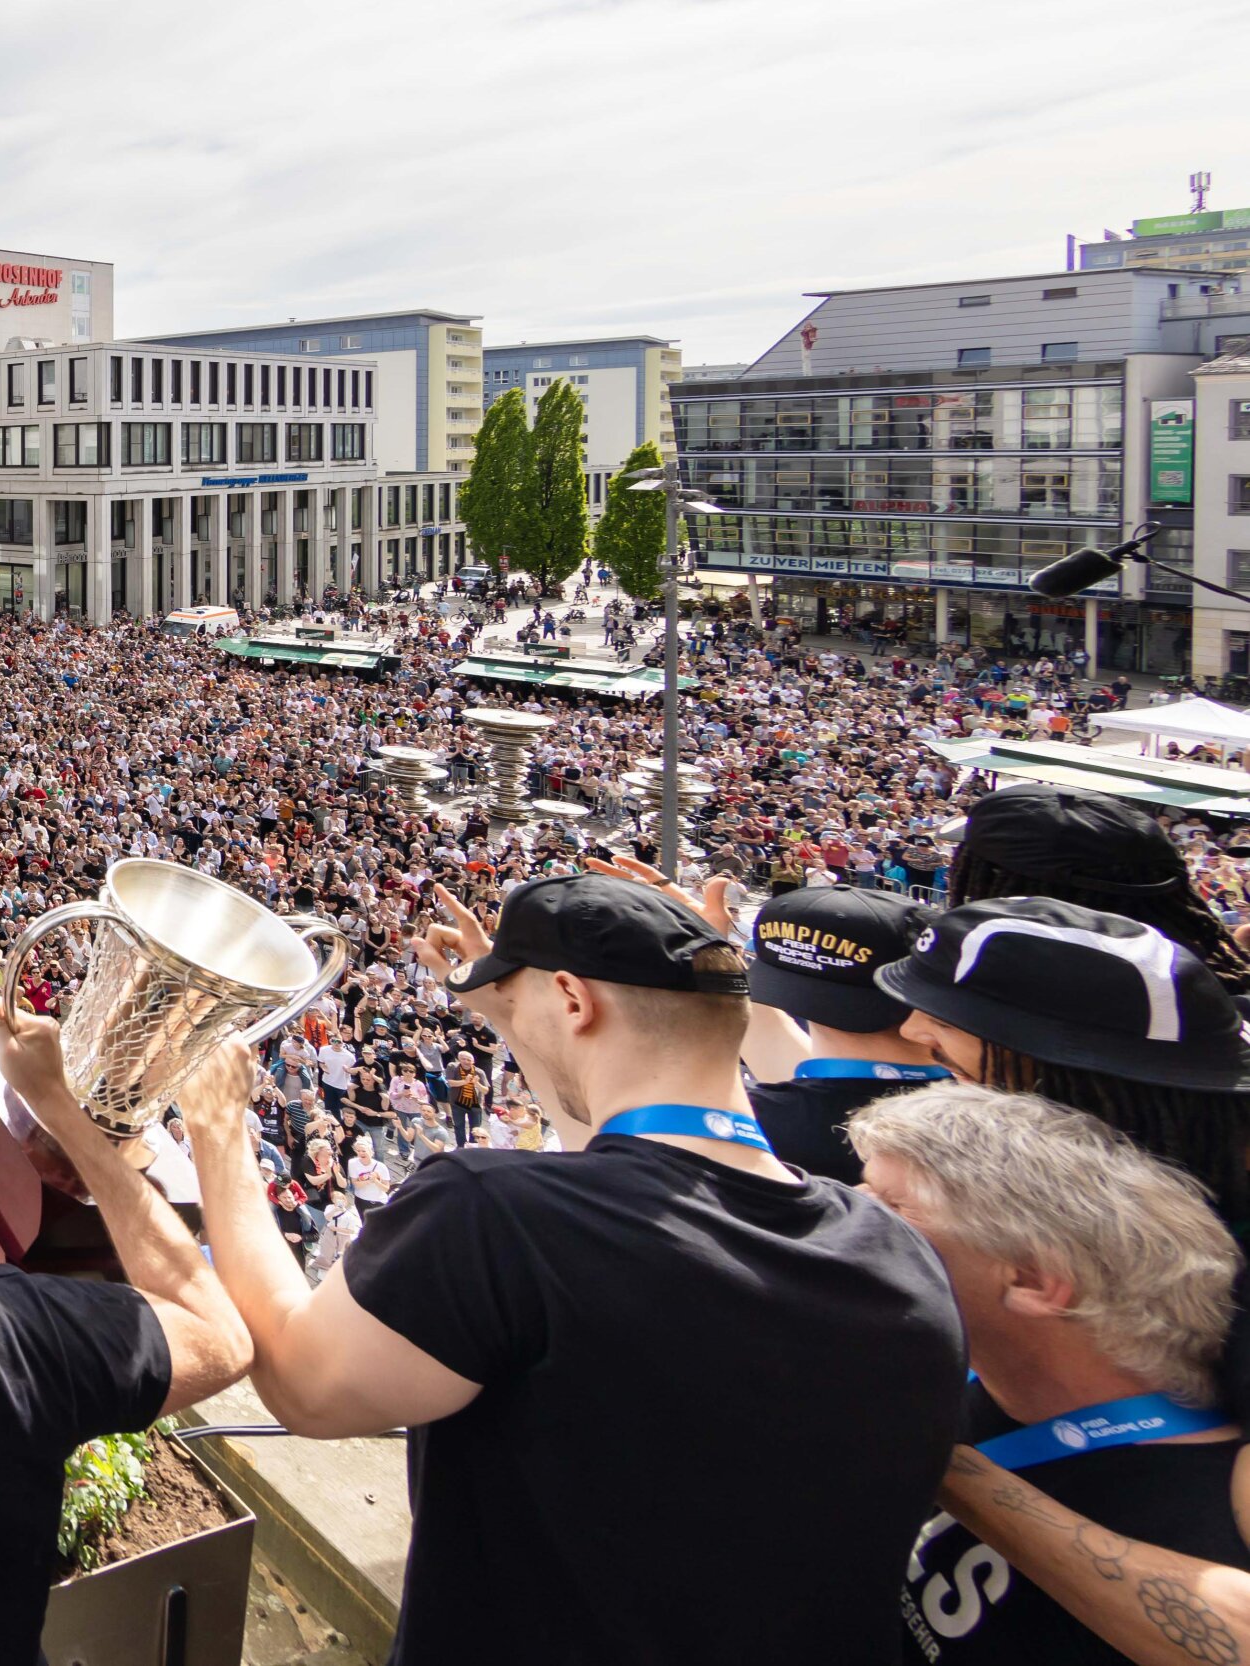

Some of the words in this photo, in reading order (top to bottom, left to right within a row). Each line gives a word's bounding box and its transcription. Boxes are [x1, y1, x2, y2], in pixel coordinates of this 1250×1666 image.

[853, 500, 930, 513] ALPHA
[750, 556, 771, 566] ZU
[759, 921, 873, 963] CHAMPIONS
[816, 955, 854, 968] CUP
[1088, 1422, 1141, 1439] EUROPE
[1138, 1417, 1166, 1430] CUP
